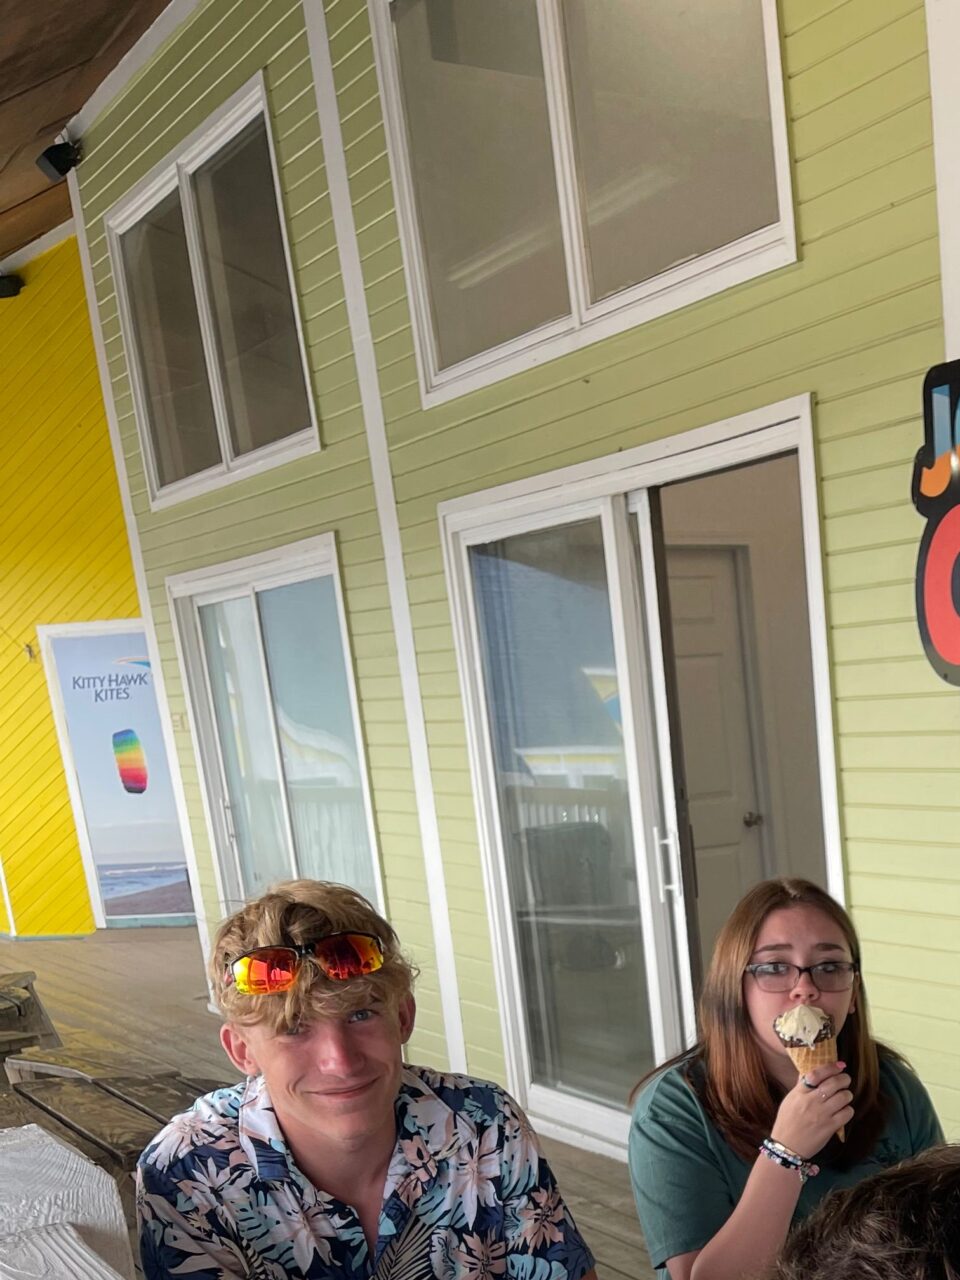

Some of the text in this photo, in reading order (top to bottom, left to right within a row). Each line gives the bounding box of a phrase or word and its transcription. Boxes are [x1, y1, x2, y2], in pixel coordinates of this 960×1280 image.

[72, 672, 148, 690] KITTY HAWK
[94, 687, 130, 702] KITES
